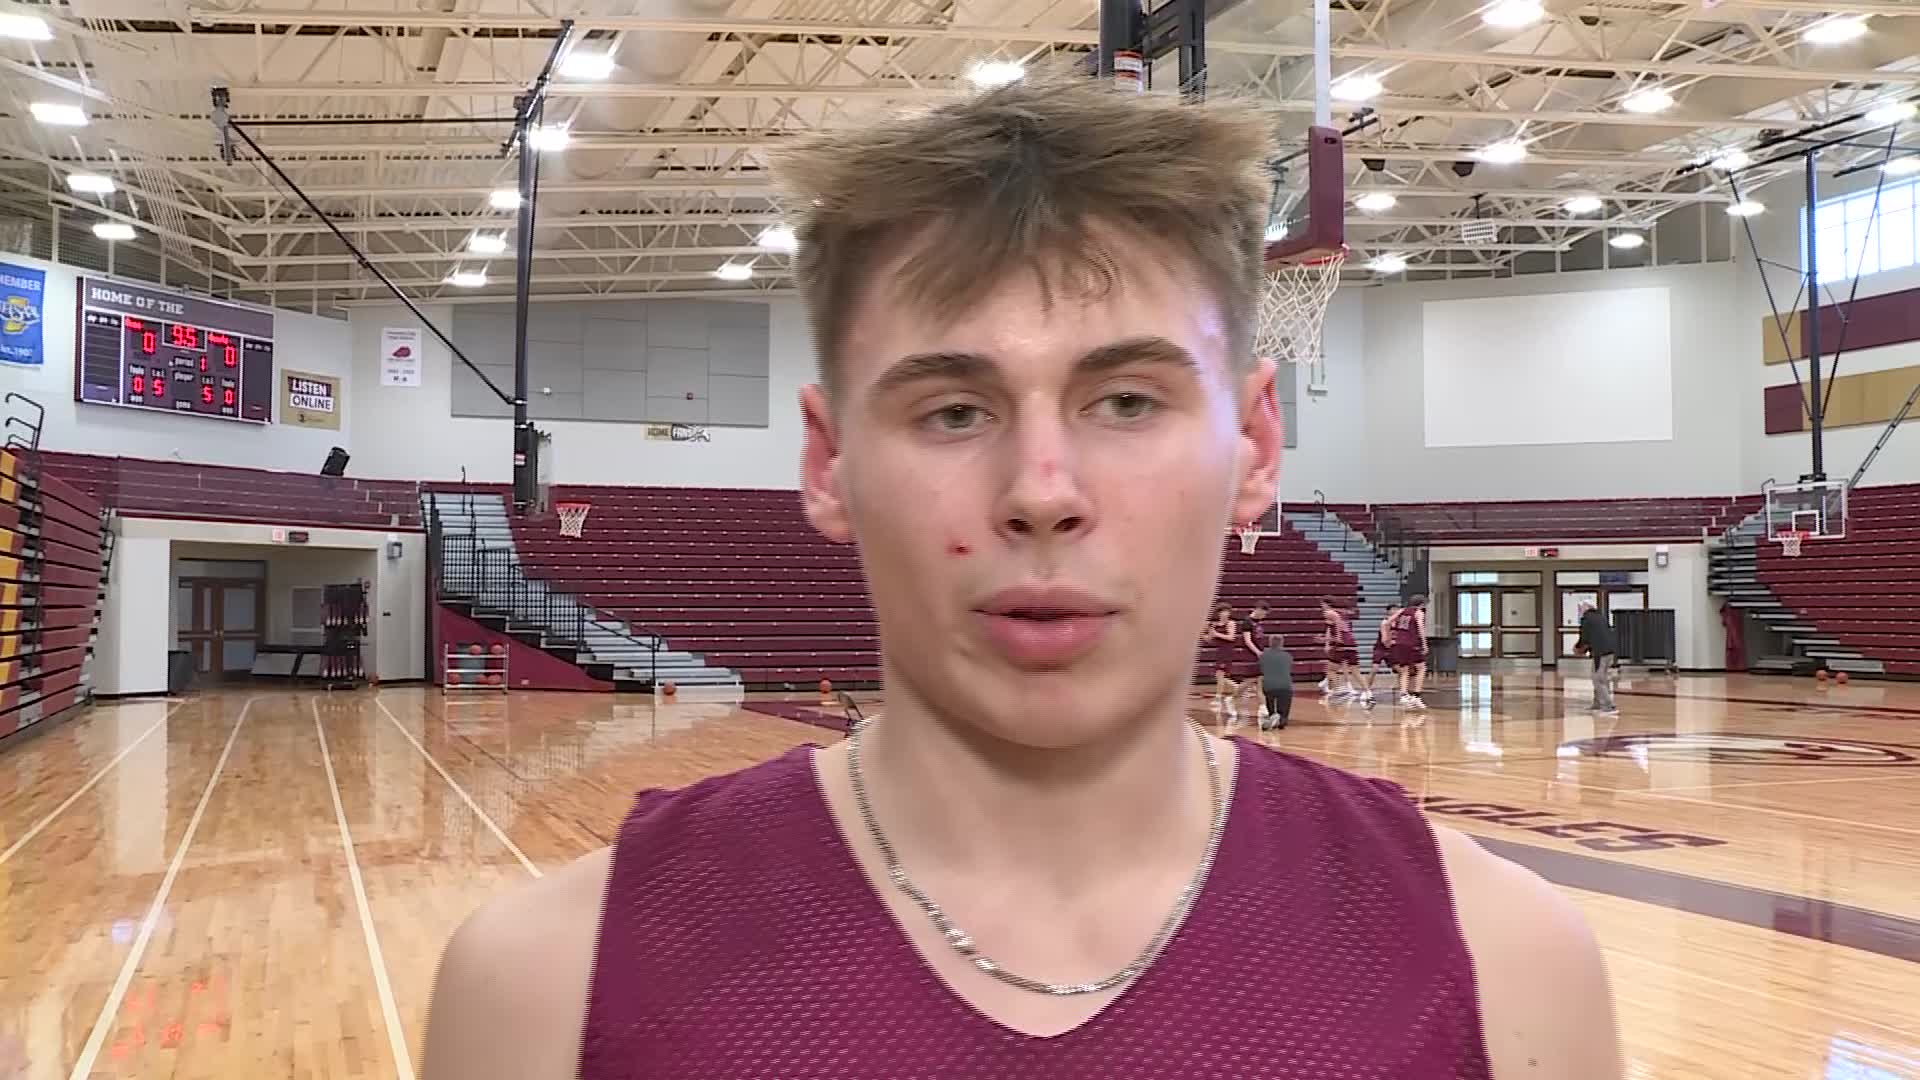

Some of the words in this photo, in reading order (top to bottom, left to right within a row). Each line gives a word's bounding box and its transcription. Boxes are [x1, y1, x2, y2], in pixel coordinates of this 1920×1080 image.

[91, 287, 132, 305] HOME
[136, 296, 155, 309] OF
[159, 301, 184, 314] THE
[143, 331, 155, 353] 0
[225, 345, 237, 367] 0
[132, 376, 144, 394] 0
[153, 380, 164, 396] 5
[202, 385, 213, 402] 5
[292, 379, 327, 396] LISTEN
[224, 389, 235, 405] 0
[292, 395, 331, 410] ONLINE
